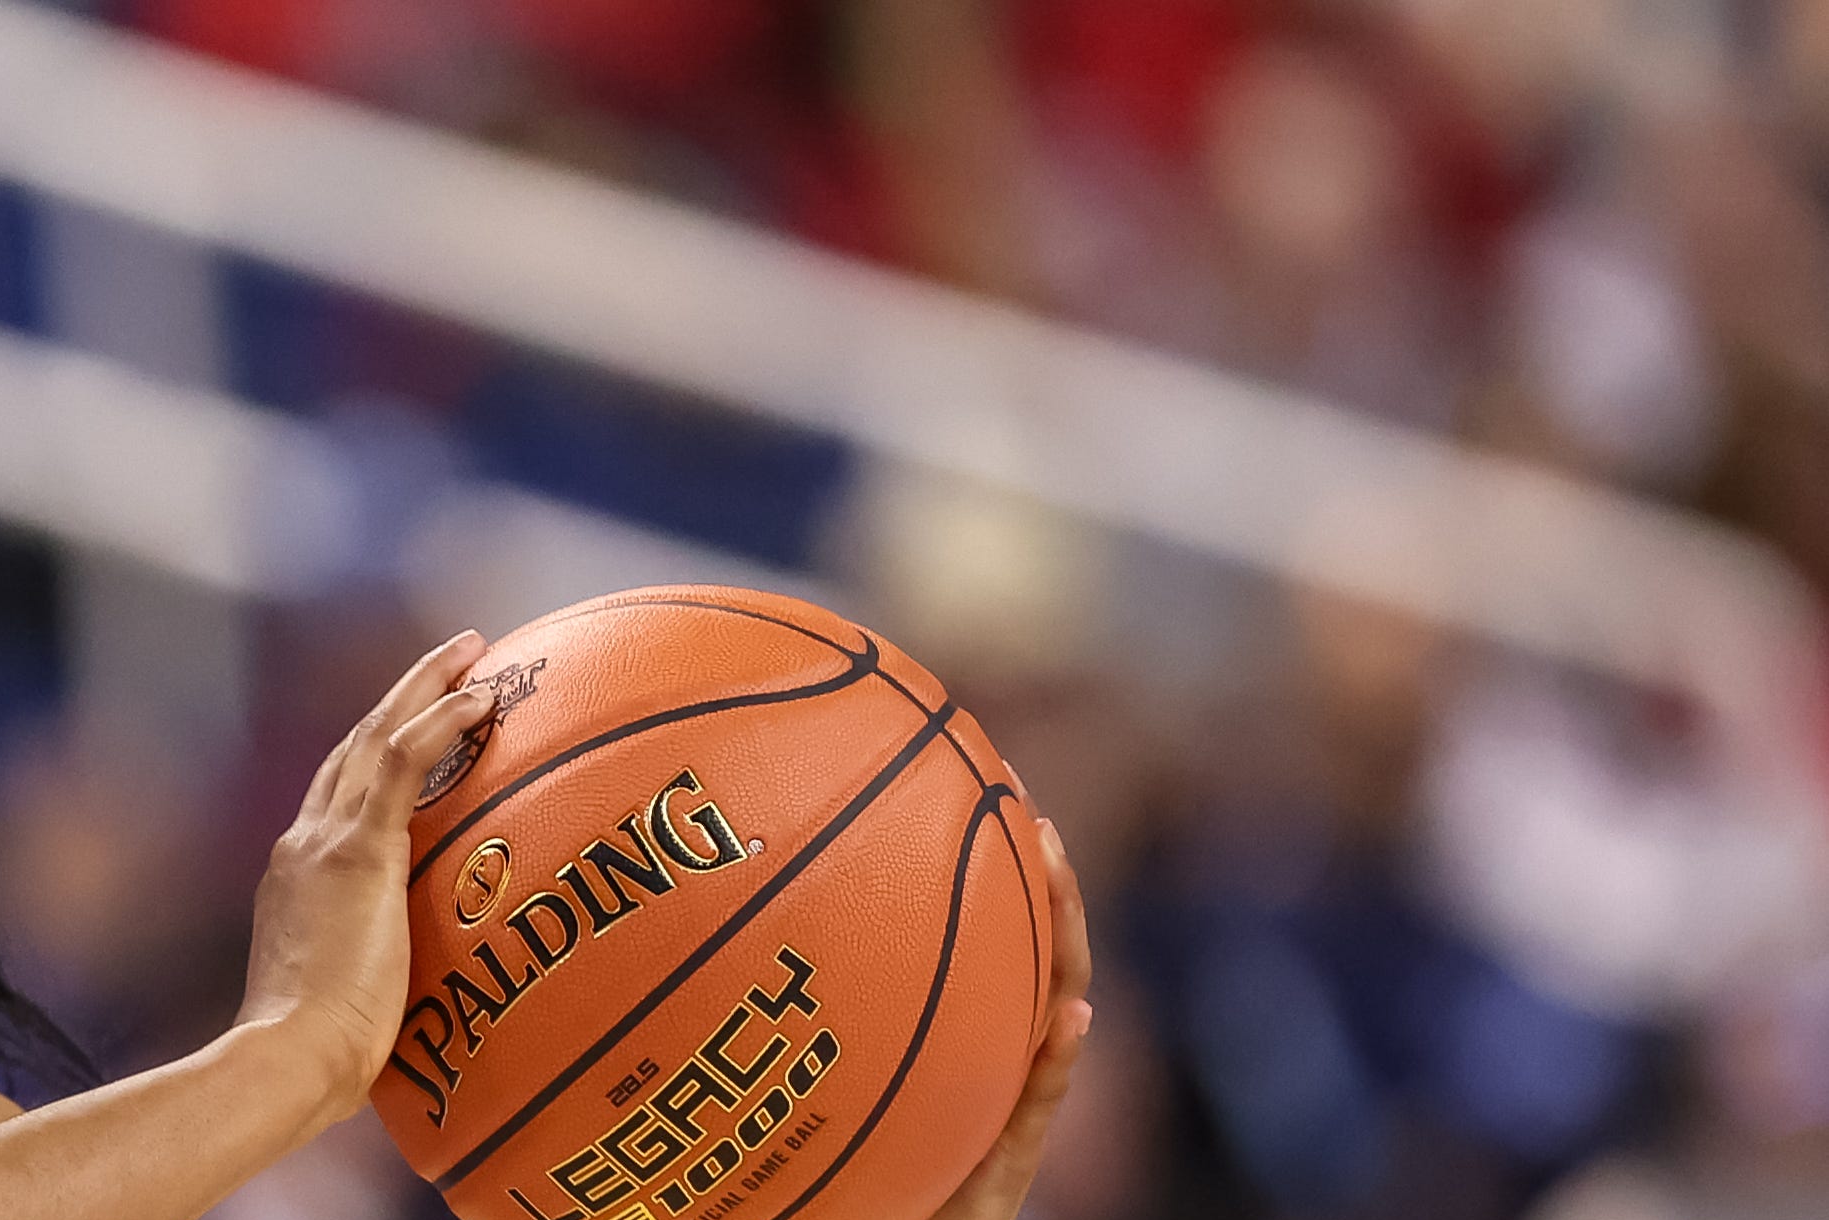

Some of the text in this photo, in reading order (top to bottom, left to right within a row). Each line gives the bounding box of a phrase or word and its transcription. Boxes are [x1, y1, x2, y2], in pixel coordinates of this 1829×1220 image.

[390, 765, 749, 1131] SPALDING
[605, 1057, 661, 1108] 28.5
[650, 1027, 841, 1217] 1000
[741, 1150, 790, 1192] GAME
[784, 1112, 827, 1151] BALL
